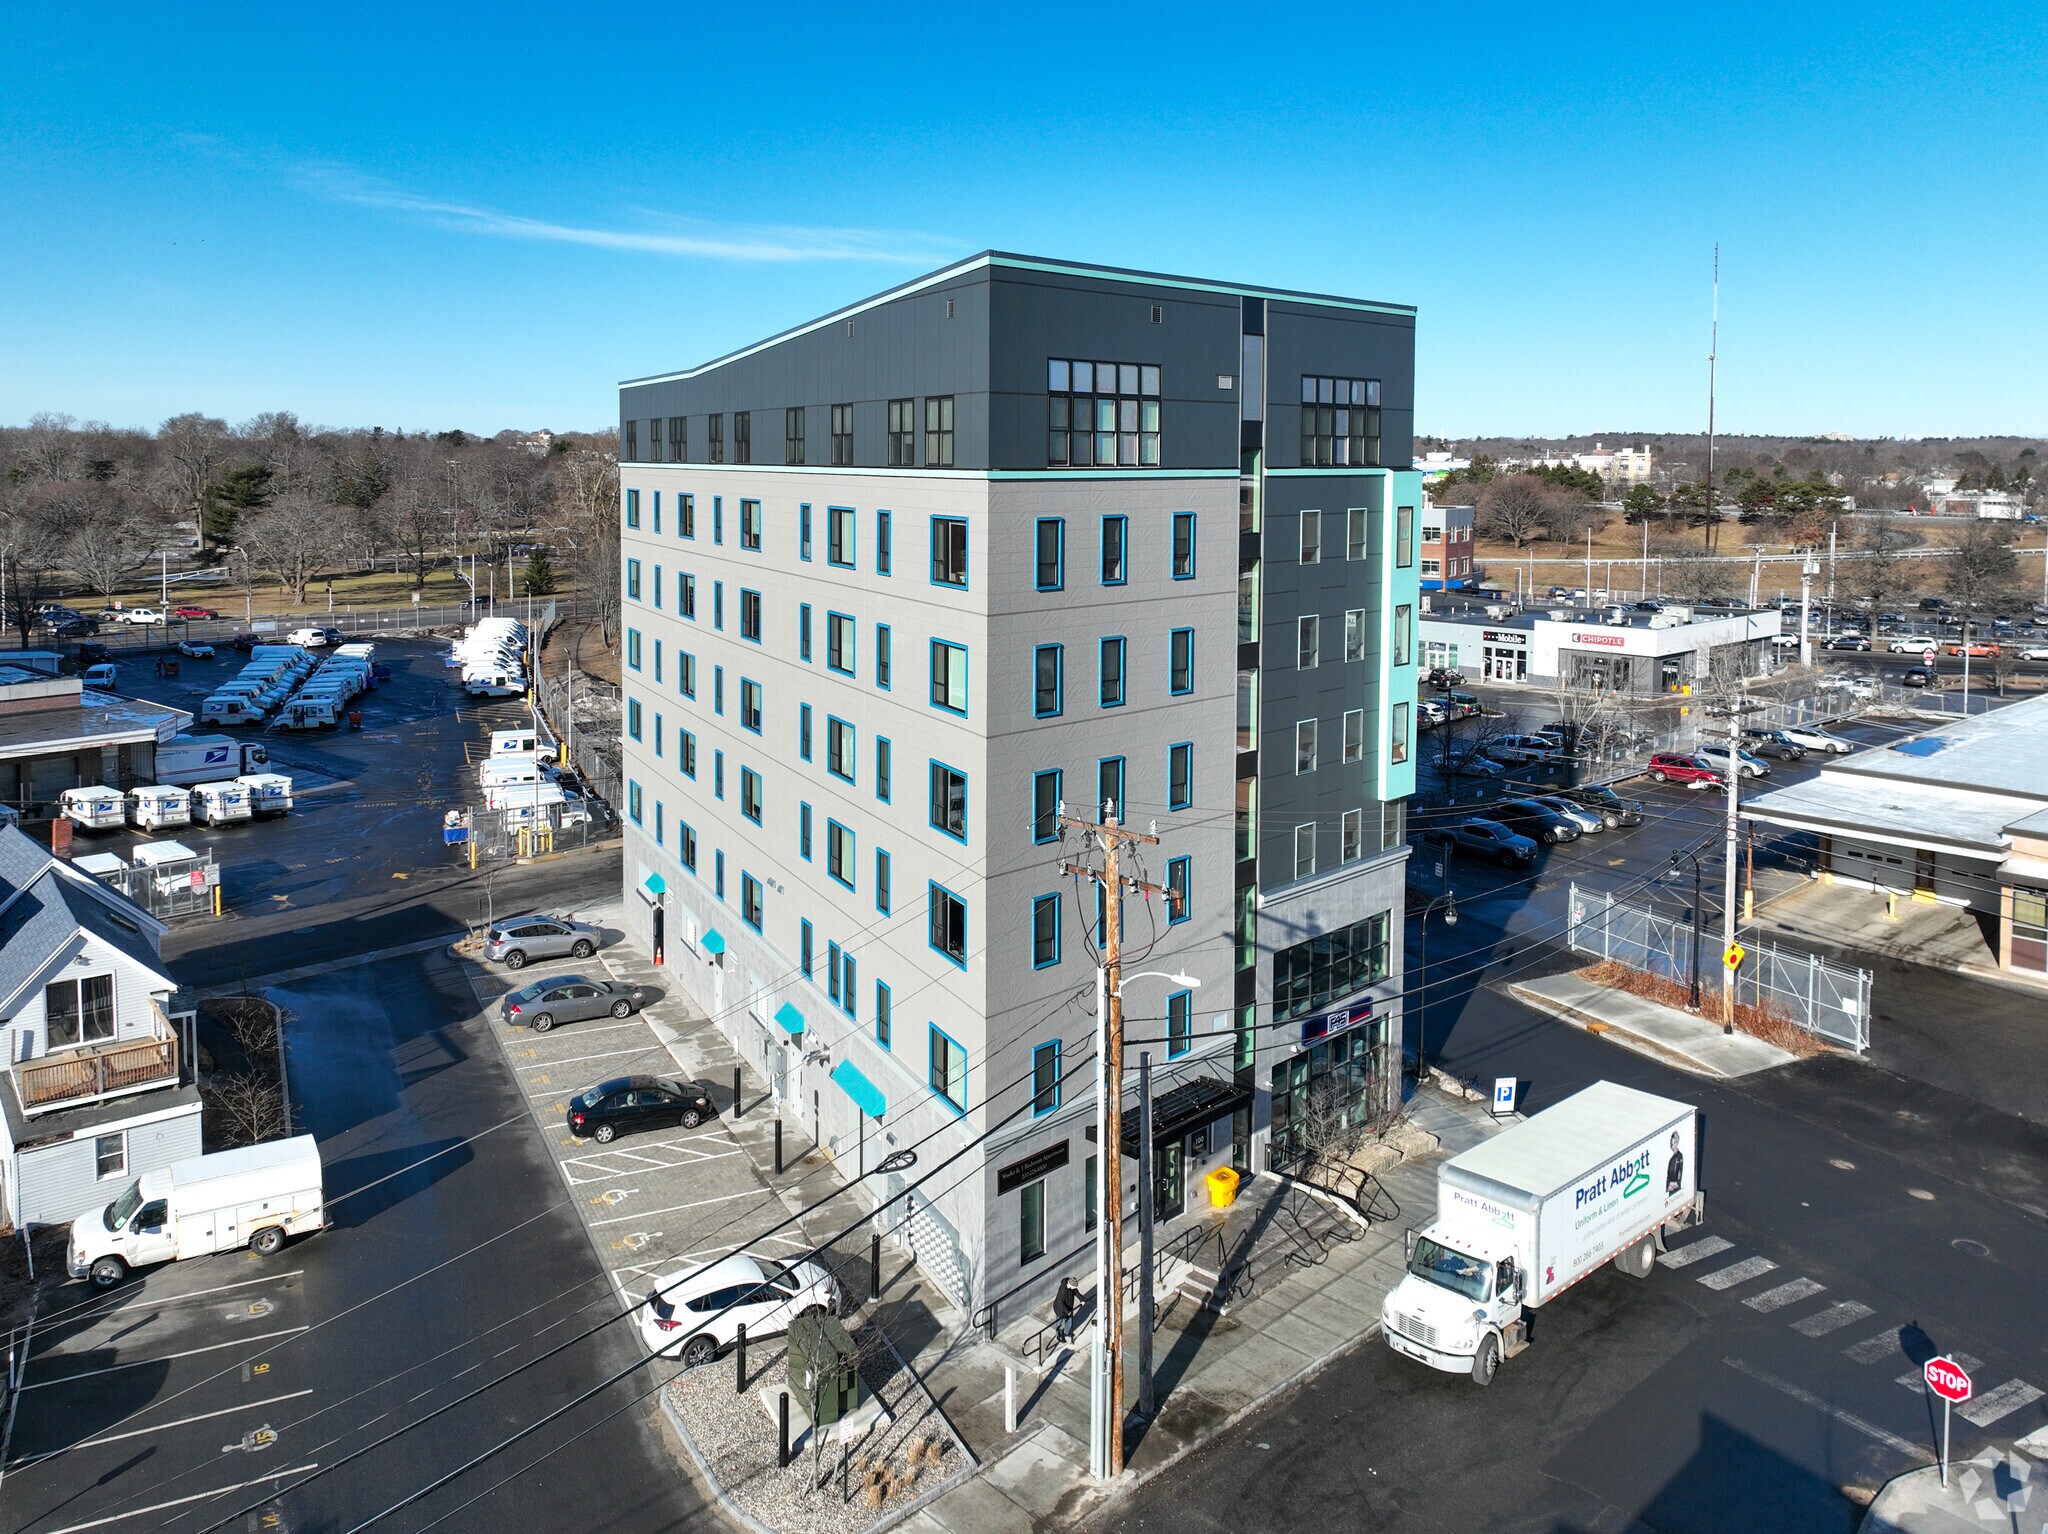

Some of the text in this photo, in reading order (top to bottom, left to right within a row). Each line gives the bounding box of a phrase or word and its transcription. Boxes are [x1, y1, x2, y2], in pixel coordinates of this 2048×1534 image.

[1582, 635, 1623, 645] CHIPOTLE
[1454, 1192, 1479, 1208] Pratt
[1575, 1175, 1607, 1210] Pratt
[1574, 1198, 1619, 1230] Uniform & Linen
[1572, 1255, 1583, 1268] 800
[1928, 1365, 1968, 1392] STOP
